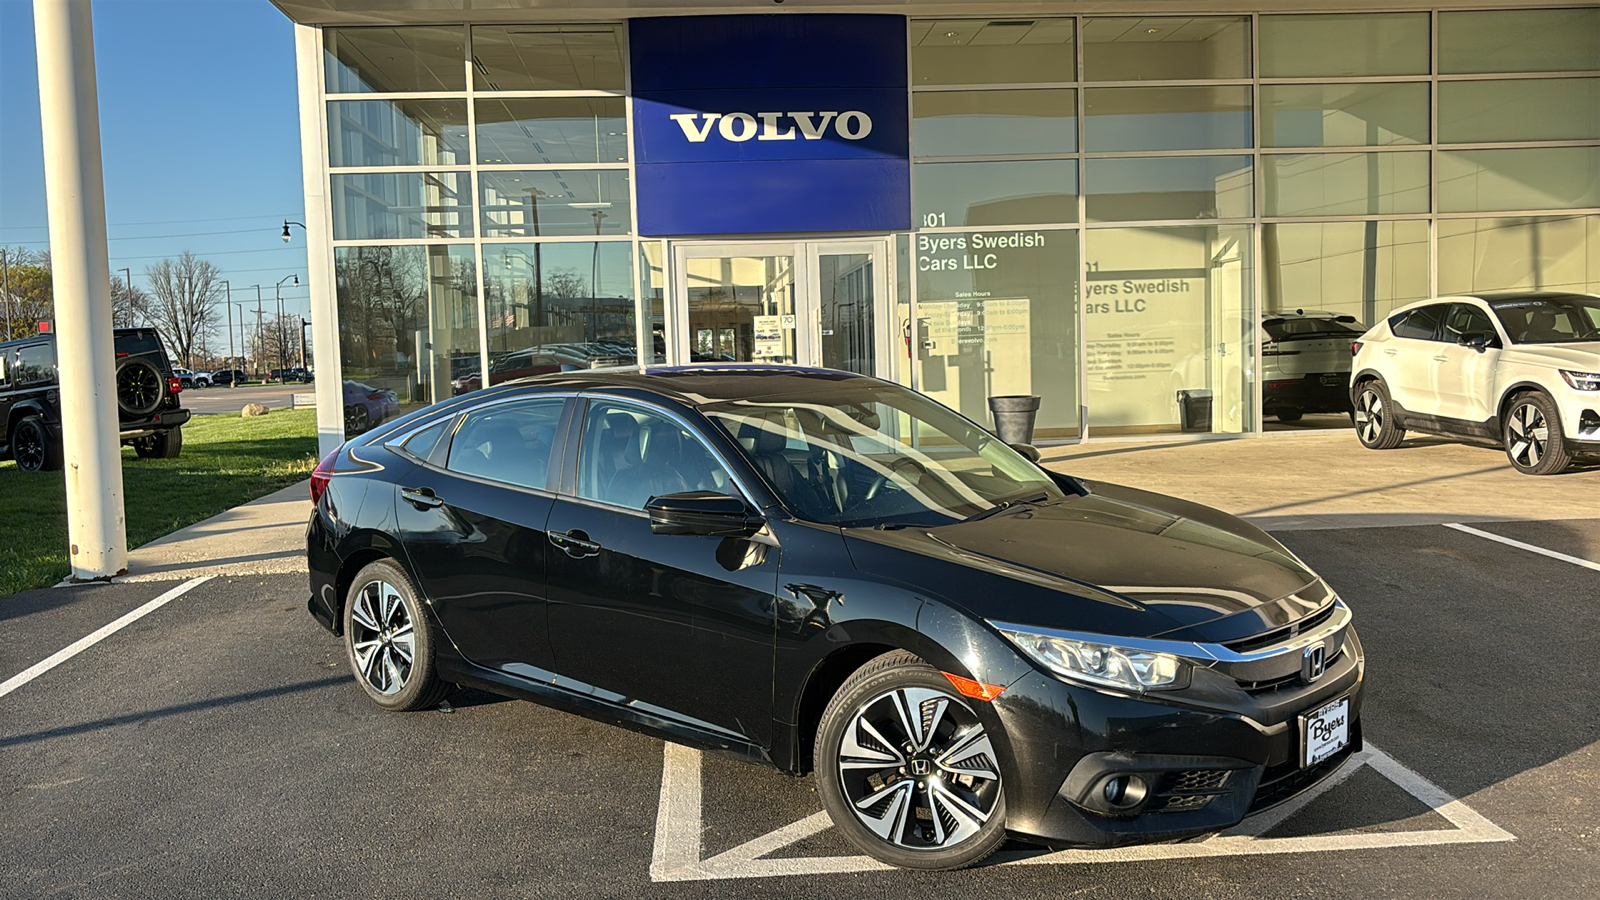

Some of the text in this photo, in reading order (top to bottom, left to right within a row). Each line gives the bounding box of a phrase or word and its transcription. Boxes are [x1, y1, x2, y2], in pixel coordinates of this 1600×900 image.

[669, 110, 873, 143] VOLVO
[919, 233, 1045, 254] Byers Swedish
[919, 253, 998, 271] Cars LLC
[1123, 280, 1189, 293] Swedish
[1115, 299, 1146, 313] LLC
[783, 316, 794, 324] 70
[1309, 714, 1345, 742] Byers
